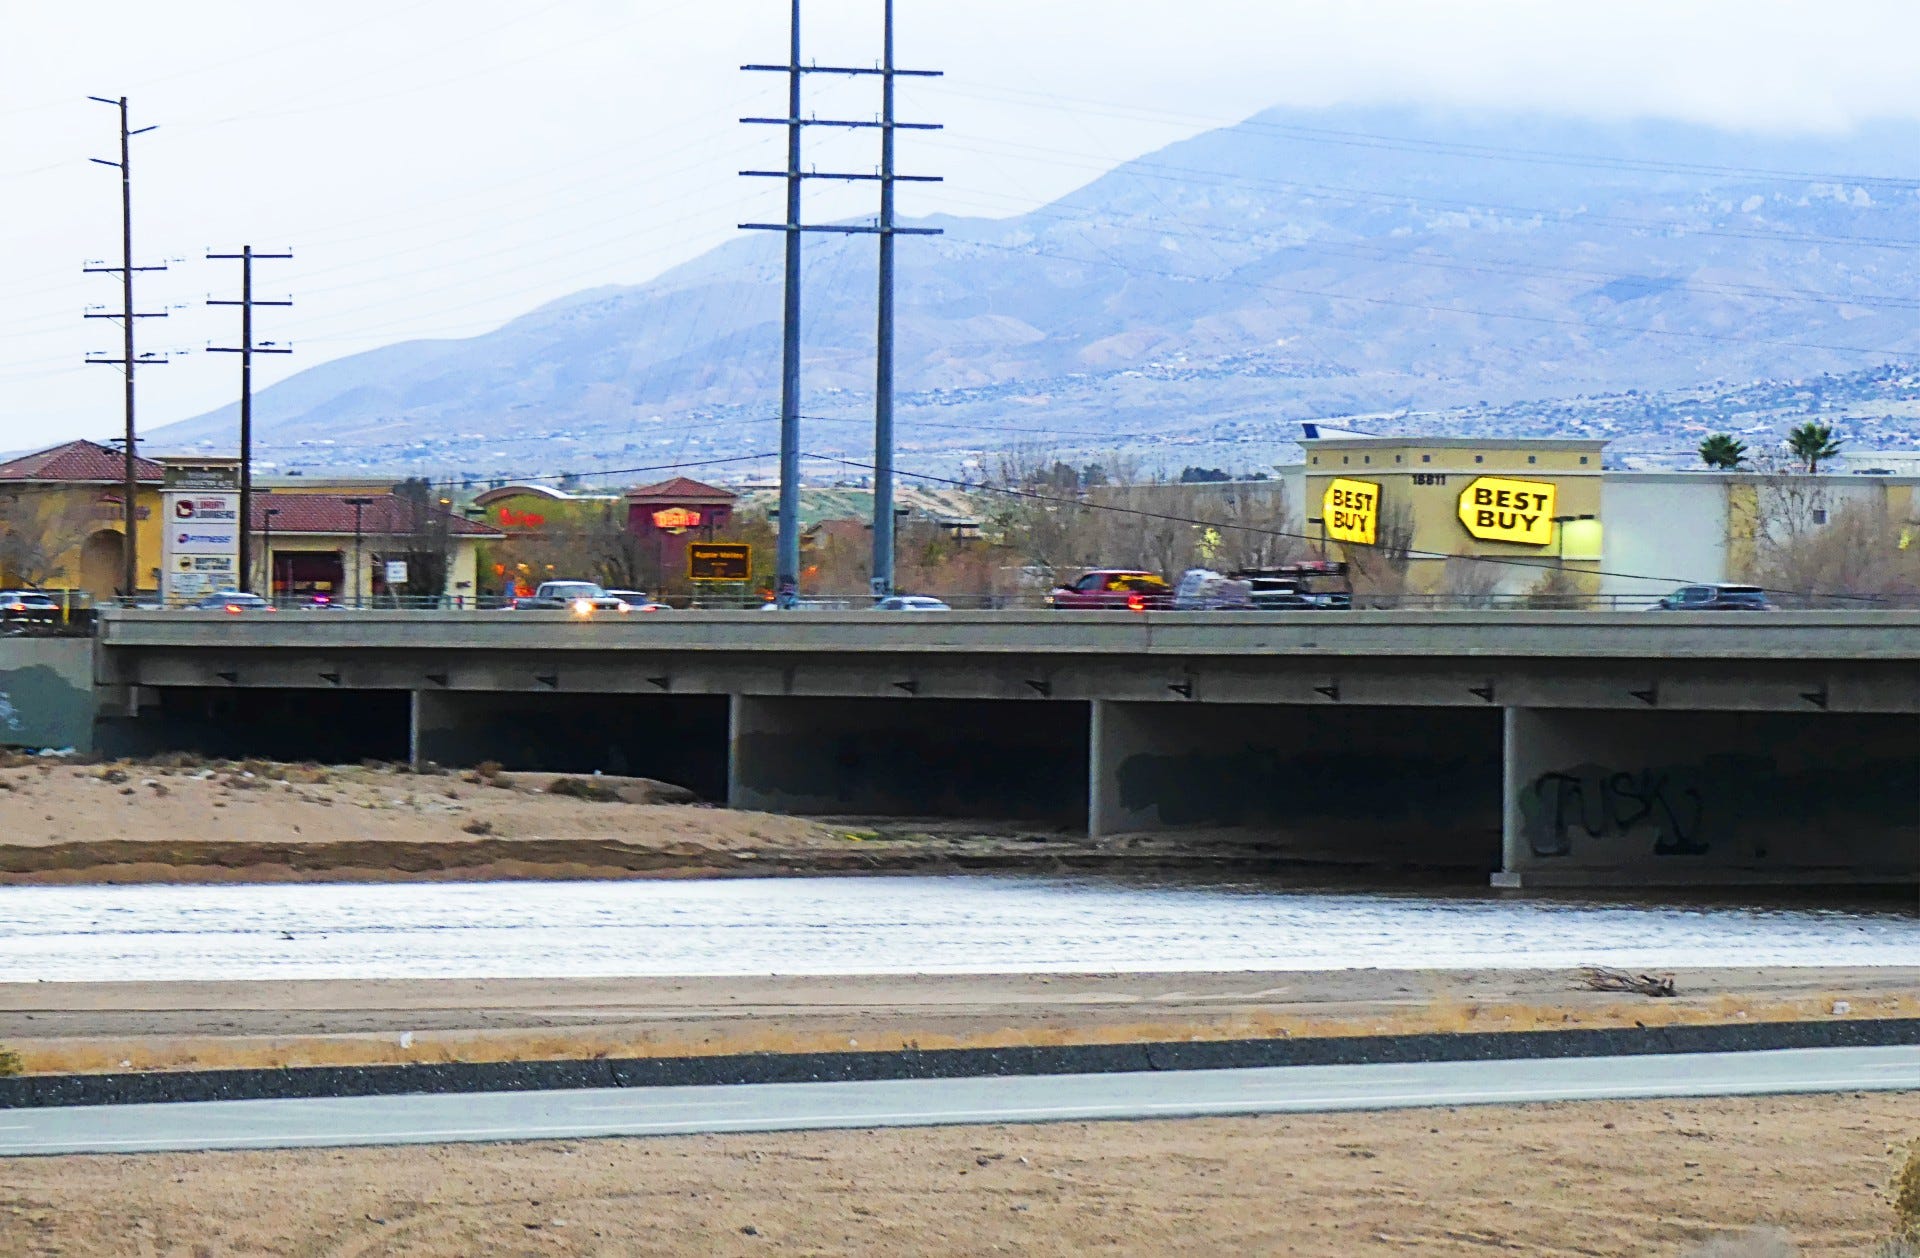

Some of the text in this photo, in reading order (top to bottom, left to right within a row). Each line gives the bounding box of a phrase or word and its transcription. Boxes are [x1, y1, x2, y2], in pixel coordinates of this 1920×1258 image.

[1333, 489, 1373, 512] BEST
[1474, 487, 1548, 512] BEST
[1333, 511, 1369, 532] BUY
[1476, 510, 1540, 532] BUY
